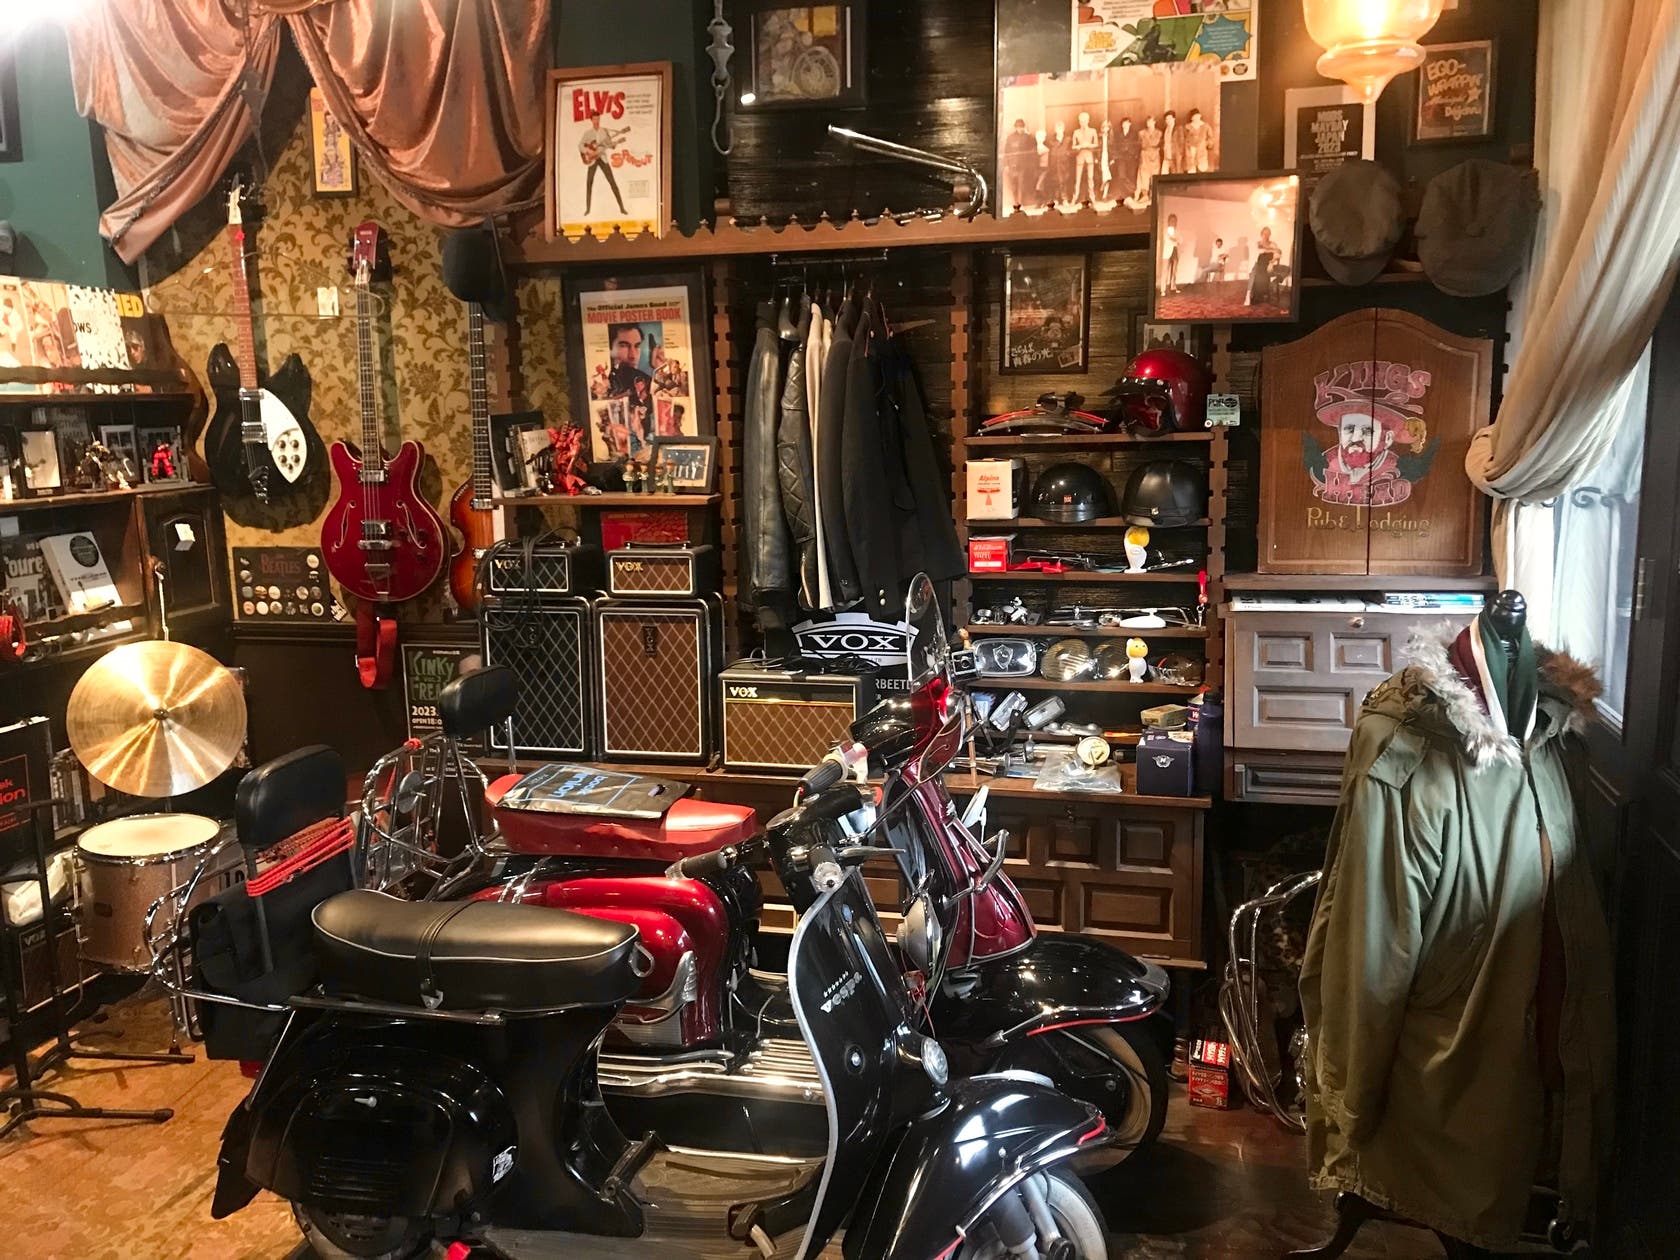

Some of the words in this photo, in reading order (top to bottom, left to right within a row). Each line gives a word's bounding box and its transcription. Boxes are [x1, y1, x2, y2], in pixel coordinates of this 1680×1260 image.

[572, 88, 626, 122] ELVIS
[598, 302, 624, 311] Official
[625, 302, 649, 310] James
[649, 301, 668, 309] Bond
[587, 310, 617, 325] MOVIE
[620, 308, 653, 322] POSTER
[656, 306, 682, 321] BOOK
[1313, 360, 1432, 410] KINGS
[495, 559, 521, 570] VOX
[616, 561, 644, 572] VOX
[808, 633, 900, 650] VOX
[730, 686, 758, 698] VOX
